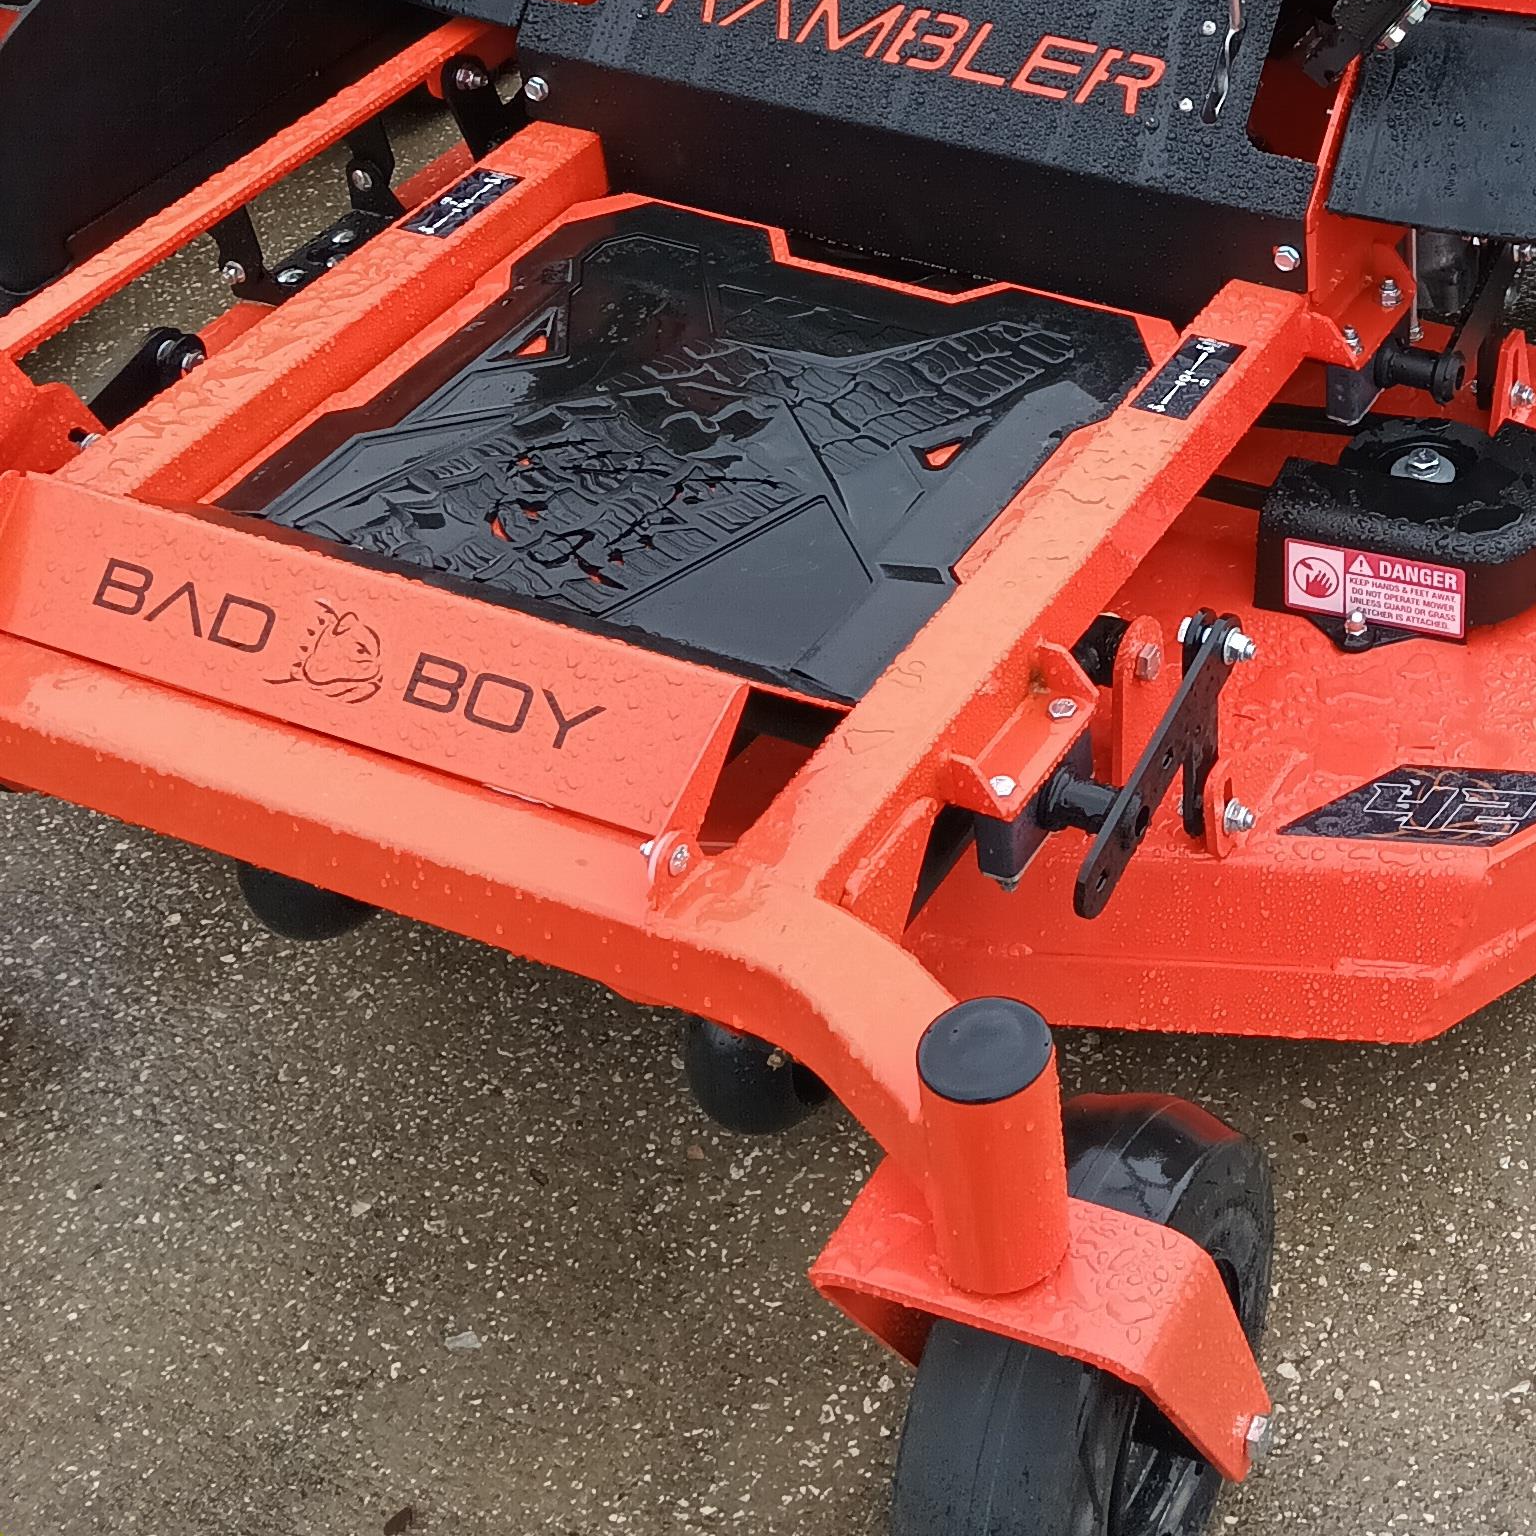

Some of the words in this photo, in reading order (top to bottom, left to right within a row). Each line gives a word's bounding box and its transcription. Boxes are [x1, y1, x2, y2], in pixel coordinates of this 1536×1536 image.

[1349, 576, 1369, 587] KEEP
[1372, 580, 1400, 592] HANDS
[1410, 588, 1429, 598] FEET
[1379, 560, 1457, 591] DANGER
[1350, 596, 1381, 608] UNLESS
[1384, 602, 1412, 613] GUARD
[1414, 608, 1426, 616] OR
[1428, 610, 1456, 622] GRASS
[1351, 586, 1363, 595] DO
[1366, 589, 1381, 599] NOT
[1384, 593, 1420, 605] OPERATE
[1423, 600, 1455, 612] MOWER
[1395, 613, 1403, 621] IS
[92, 557, 276, 653] BAD
[402, 652, 607, 750] BOY
